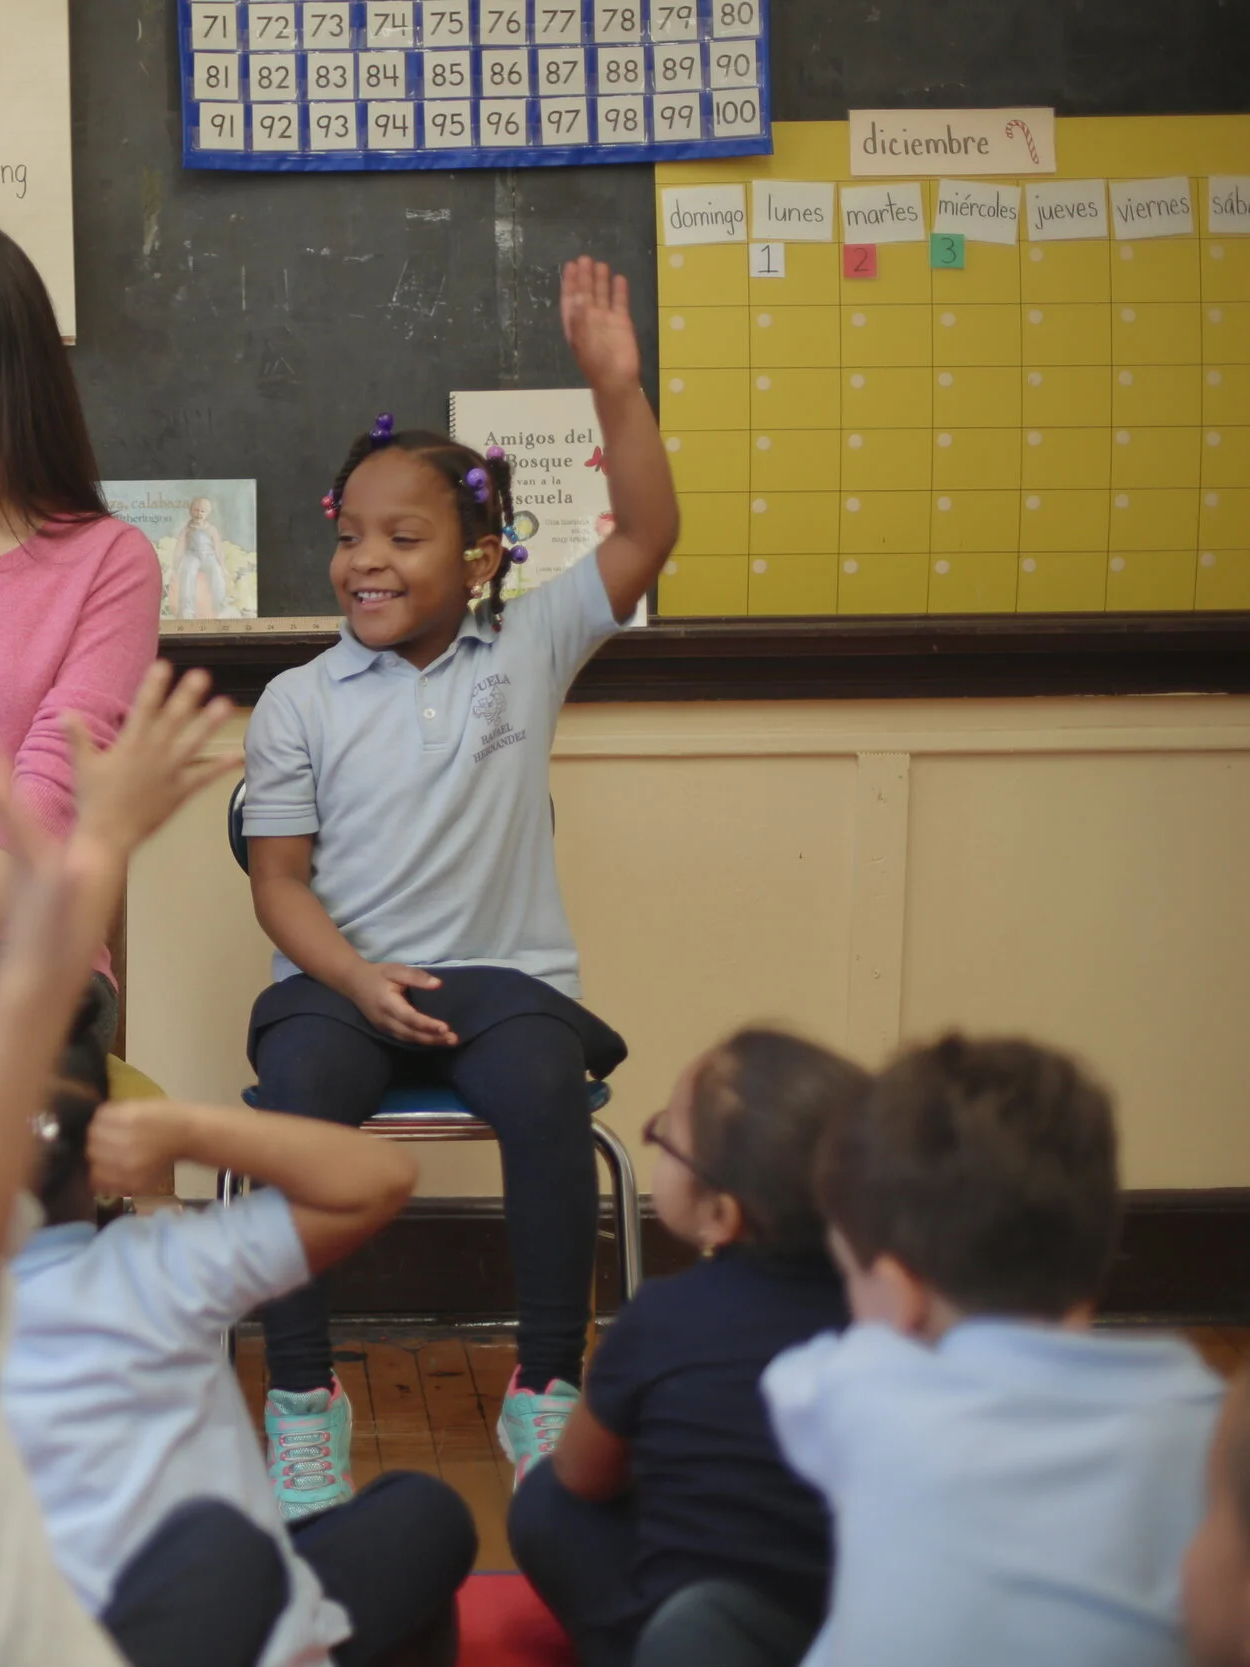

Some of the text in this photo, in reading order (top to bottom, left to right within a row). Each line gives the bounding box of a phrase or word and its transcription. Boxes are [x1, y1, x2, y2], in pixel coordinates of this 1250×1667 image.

[203, 2, 754, 39] 71 72 73 74 75 76 77 78 79 80
[206, 53, 750, 89] 81 82 83 84 85 86 87 88 89 90
[210, 100, 756, 139] 91 92 93 94 95 96 97 98 99 100
[862, 121, 989, 156] diciembre
[670, 184, 1250, 236] domingo lunes martes miércoles jueves viernes sáb
[758, 244, 779, 274] 1
[853, 247, 869, 272] 2
[940, 237, 957, 264] 3
[484, 428, 594, 450] Amigos del
[505, 453, 574, 472] Bosque
[516, 476, 561, 486] van a la
